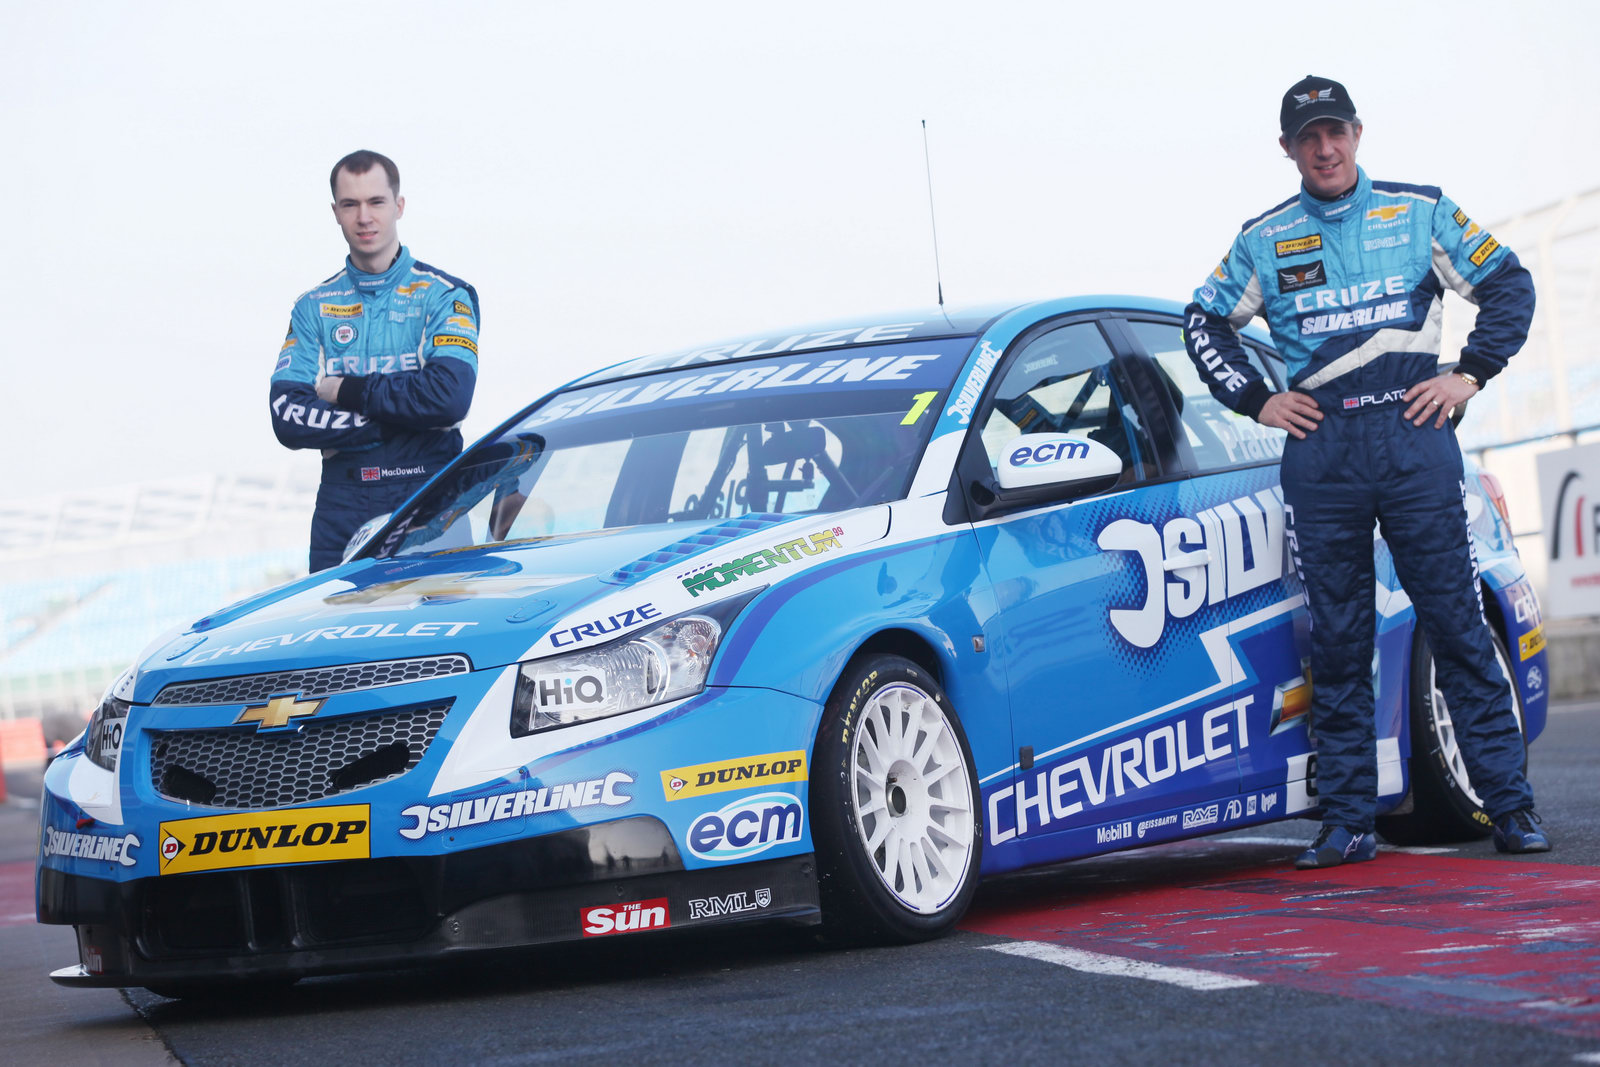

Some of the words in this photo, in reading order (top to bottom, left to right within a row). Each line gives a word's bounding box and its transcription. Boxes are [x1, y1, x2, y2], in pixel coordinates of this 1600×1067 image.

[1285, 239, 1319, 249] DUNLOP
[1294, 275, 1406, 313] CRUZE
[326, 352, 418, 376] CRUZE
[1188, 313, 1248, 392] CRUZE
[900, 391, 939, 425] 1
[1009, 442, 1090, 467] ecm
[381, 465, 426, 478] MacDowall
[682, 529, 843, 598] MOMENTUM
[1163, 485, 1284, 619] SILV
[550, 603, 662, 648] CRUZE
[181, 621, 479, 667] CHEVROLET
[539, 675, 604, 708] HiQ
[696, 759, 802, 787] DUNLOP
[988, 694, 1255, 847] CHEVROLET
[690, 803, 800, 853] ecm
[1183, 804, 1219, 824] RAYS
[188, 819, 367, 857] DUNLOP
[1097, 824, 1122, 844] Mobil
[583, 907, 666, 935] Sun
[623, 903, 641, 911] THE
[689, 892, 756, 920] RML
